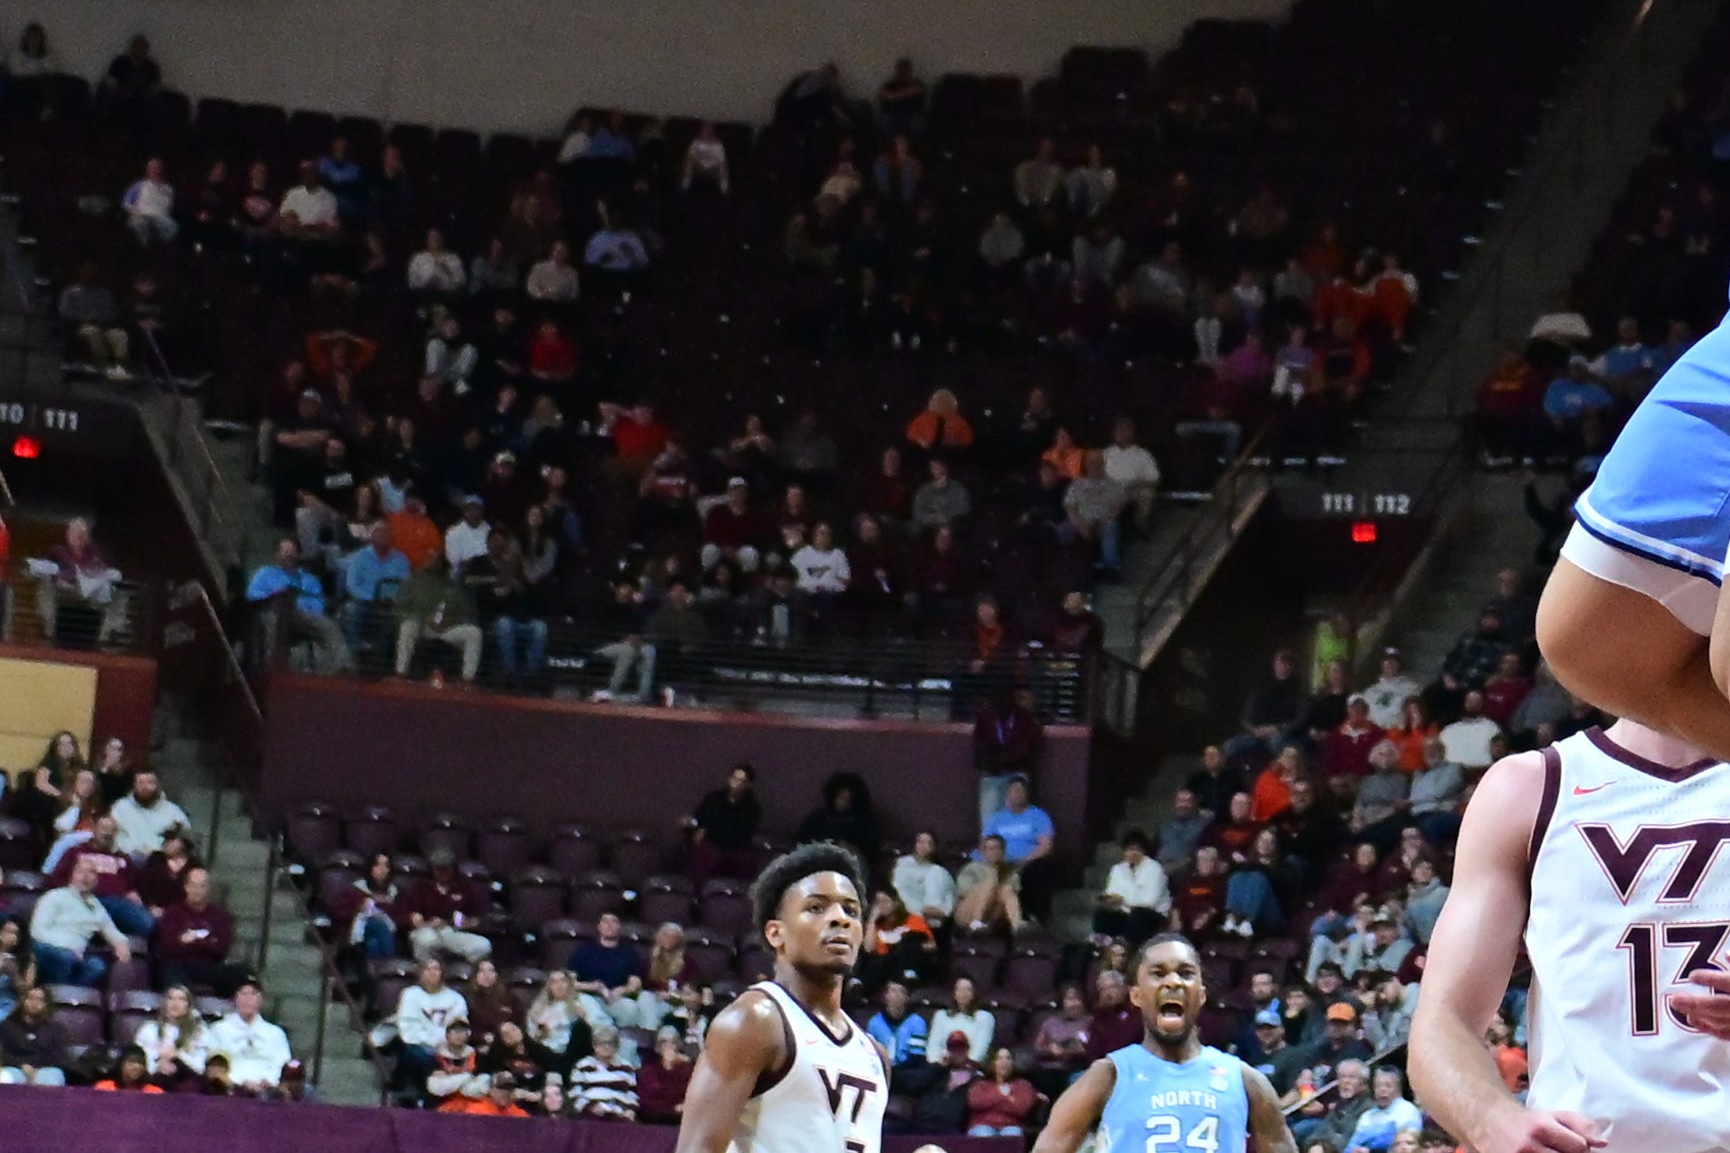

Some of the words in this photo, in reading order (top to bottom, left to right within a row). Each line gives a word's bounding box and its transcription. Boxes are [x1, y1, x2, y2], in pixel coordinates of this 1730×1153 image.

[43, 408, 79, 431] 111
[1321, 492, 1354, 513] 111
[1374, 493, 1411, 515] 112
[813, 1064, 878, 1126] VT
[1150, 1090, 1218, 1111] NORTH
[1145, 1115, 1220, 1153] 24
